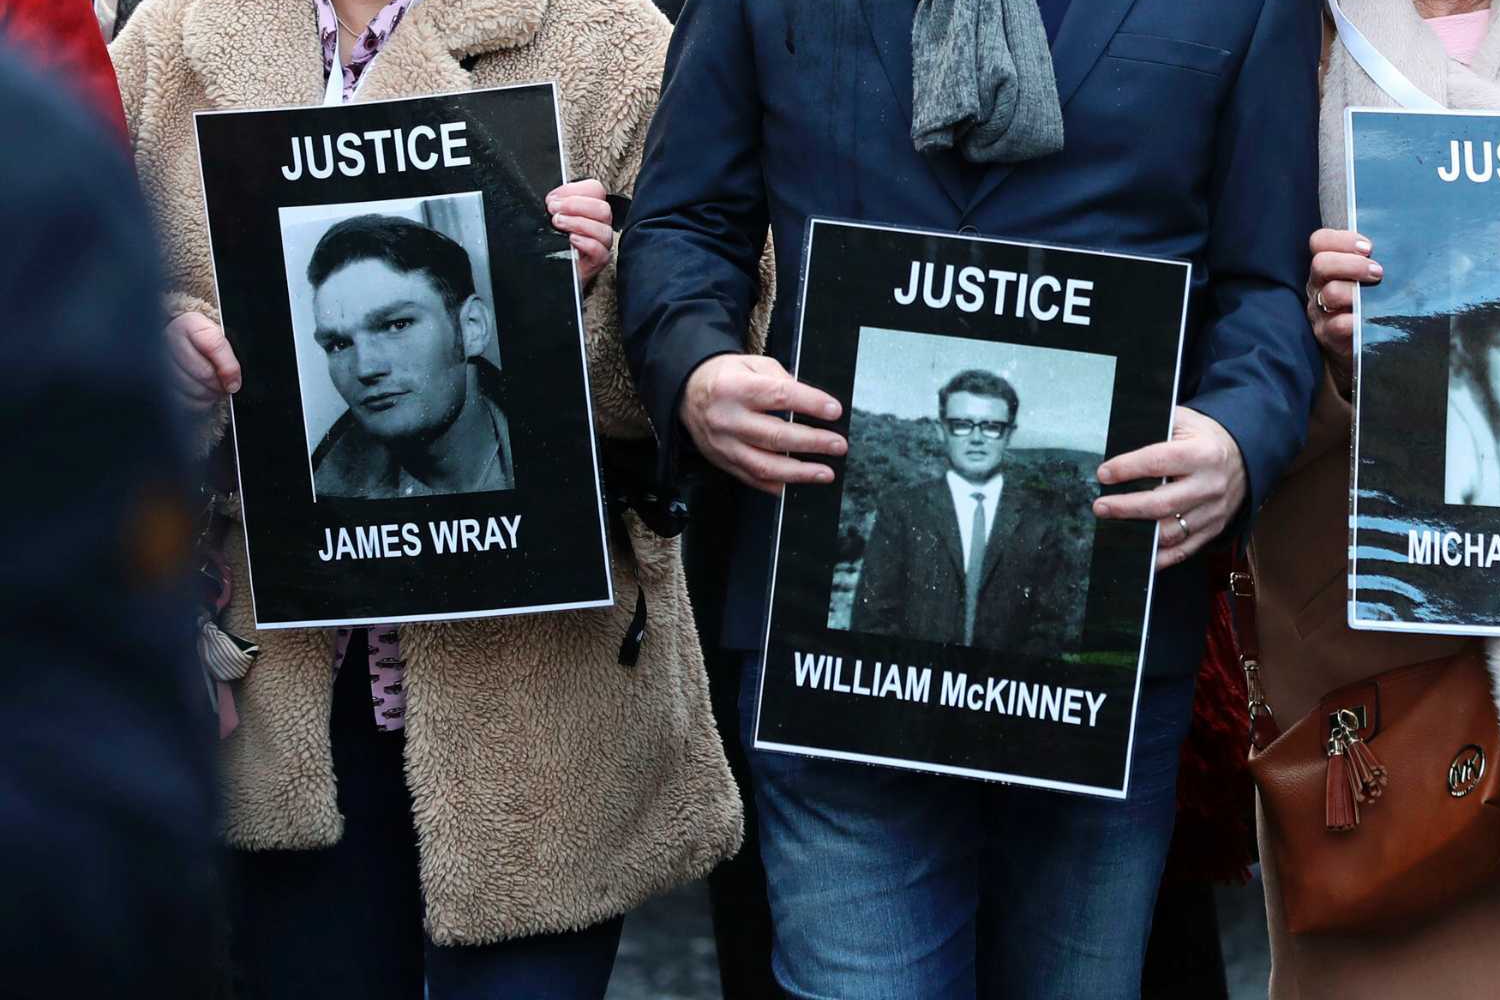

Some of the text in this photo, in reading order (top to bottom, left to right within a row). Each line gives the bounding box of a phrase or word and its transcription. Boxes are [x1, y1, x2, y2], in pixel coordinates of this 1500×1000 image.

[281, 121, 471, 181] JUSTICE
[894, 260, 1094, 326] JUSTICE
[318, 514, 522, 562] JAMES WRAY
[794, 652, 1107, 727] WILLIAM McKINNEY
